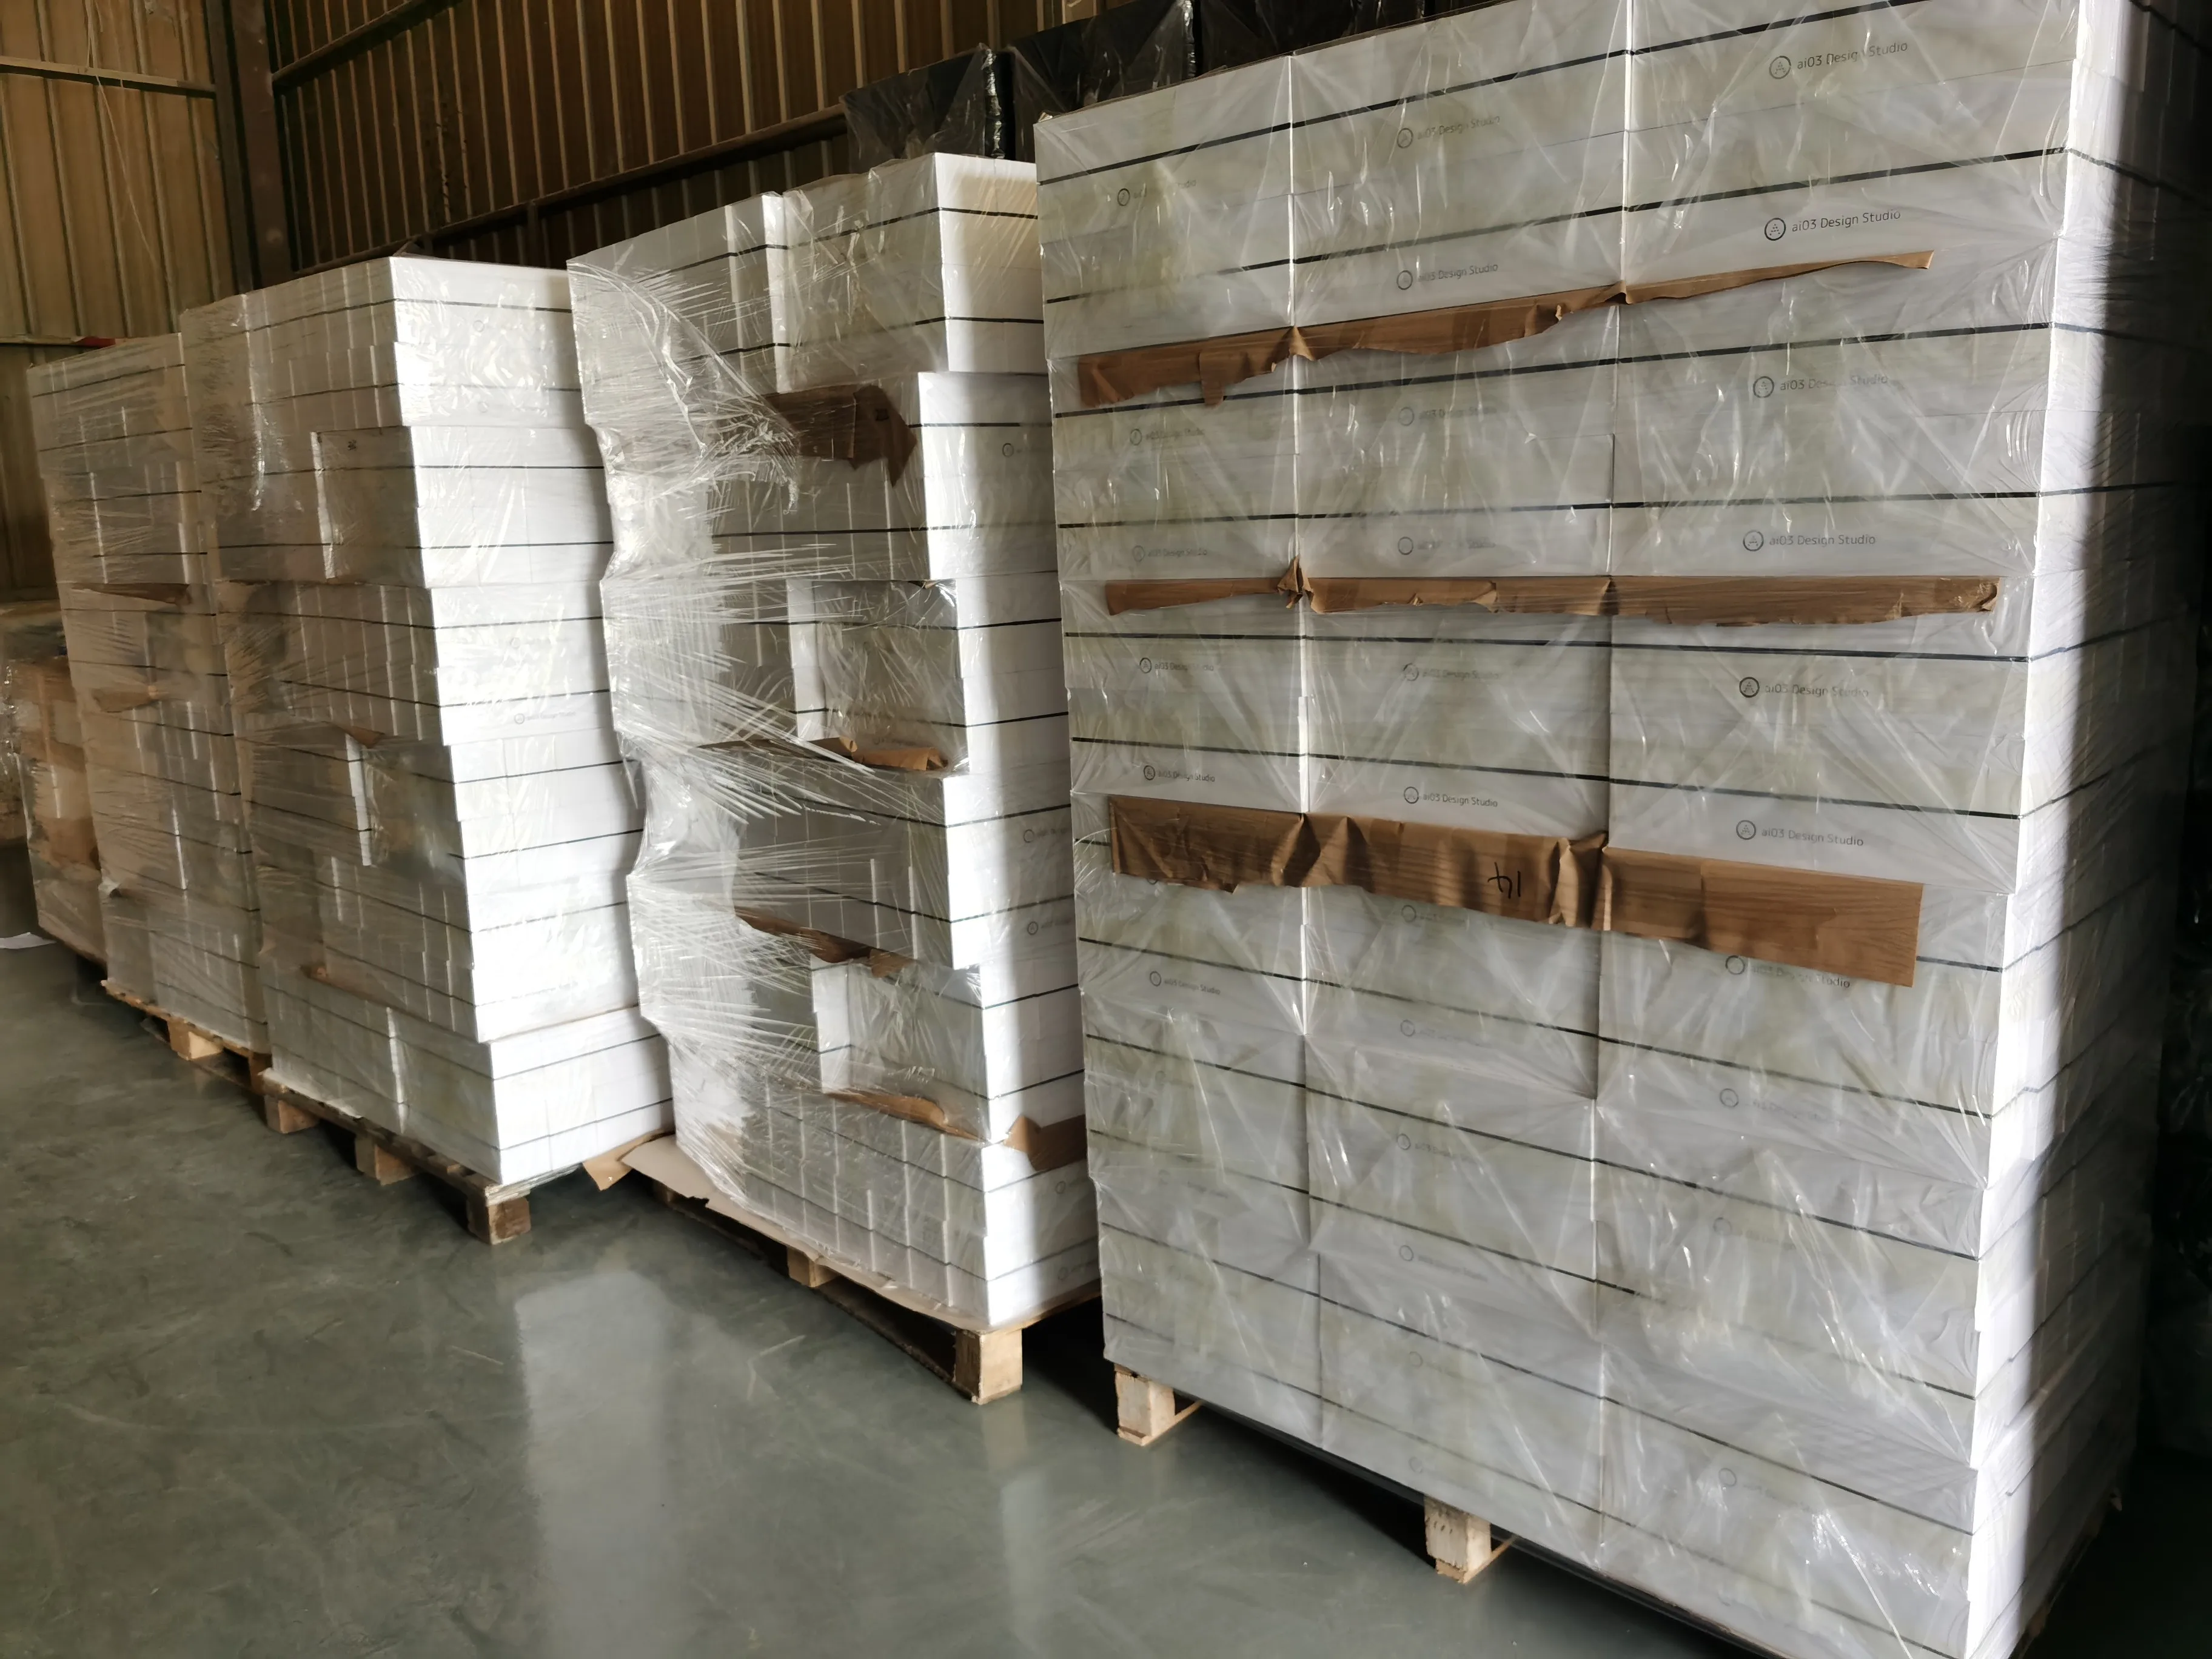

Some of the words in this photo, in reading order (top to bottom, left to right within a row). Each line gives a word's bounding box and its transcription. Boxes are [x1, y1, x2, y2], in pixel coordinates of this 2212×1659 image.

[1797, 55, 1822, 70] ai03
[1868, 42, 1908, 58] Studio
[1791, 219, 1817, 233] ai03
[1820, 214, 1858, 229] Design
[1862, 209, 1901, 223] Studio
[1780, 378, 1805, 391] ai03
[1849, 372, 1888, 386] Studio
[1769, 535, 1794, 545] ai03
[1797, 534, 1834, 548] Design
[1838, 534, 1876, 545] Studio
[1792, 684, 1829, 697] Design
[1442, 794, 1469, 806] Design
[1472, 797, 1498, 808] Studio
[1761, 827, 1785, 838] ai03
[1788, 828, 1825, 843] Design
[1827, 833, 1865, 846] Studio
